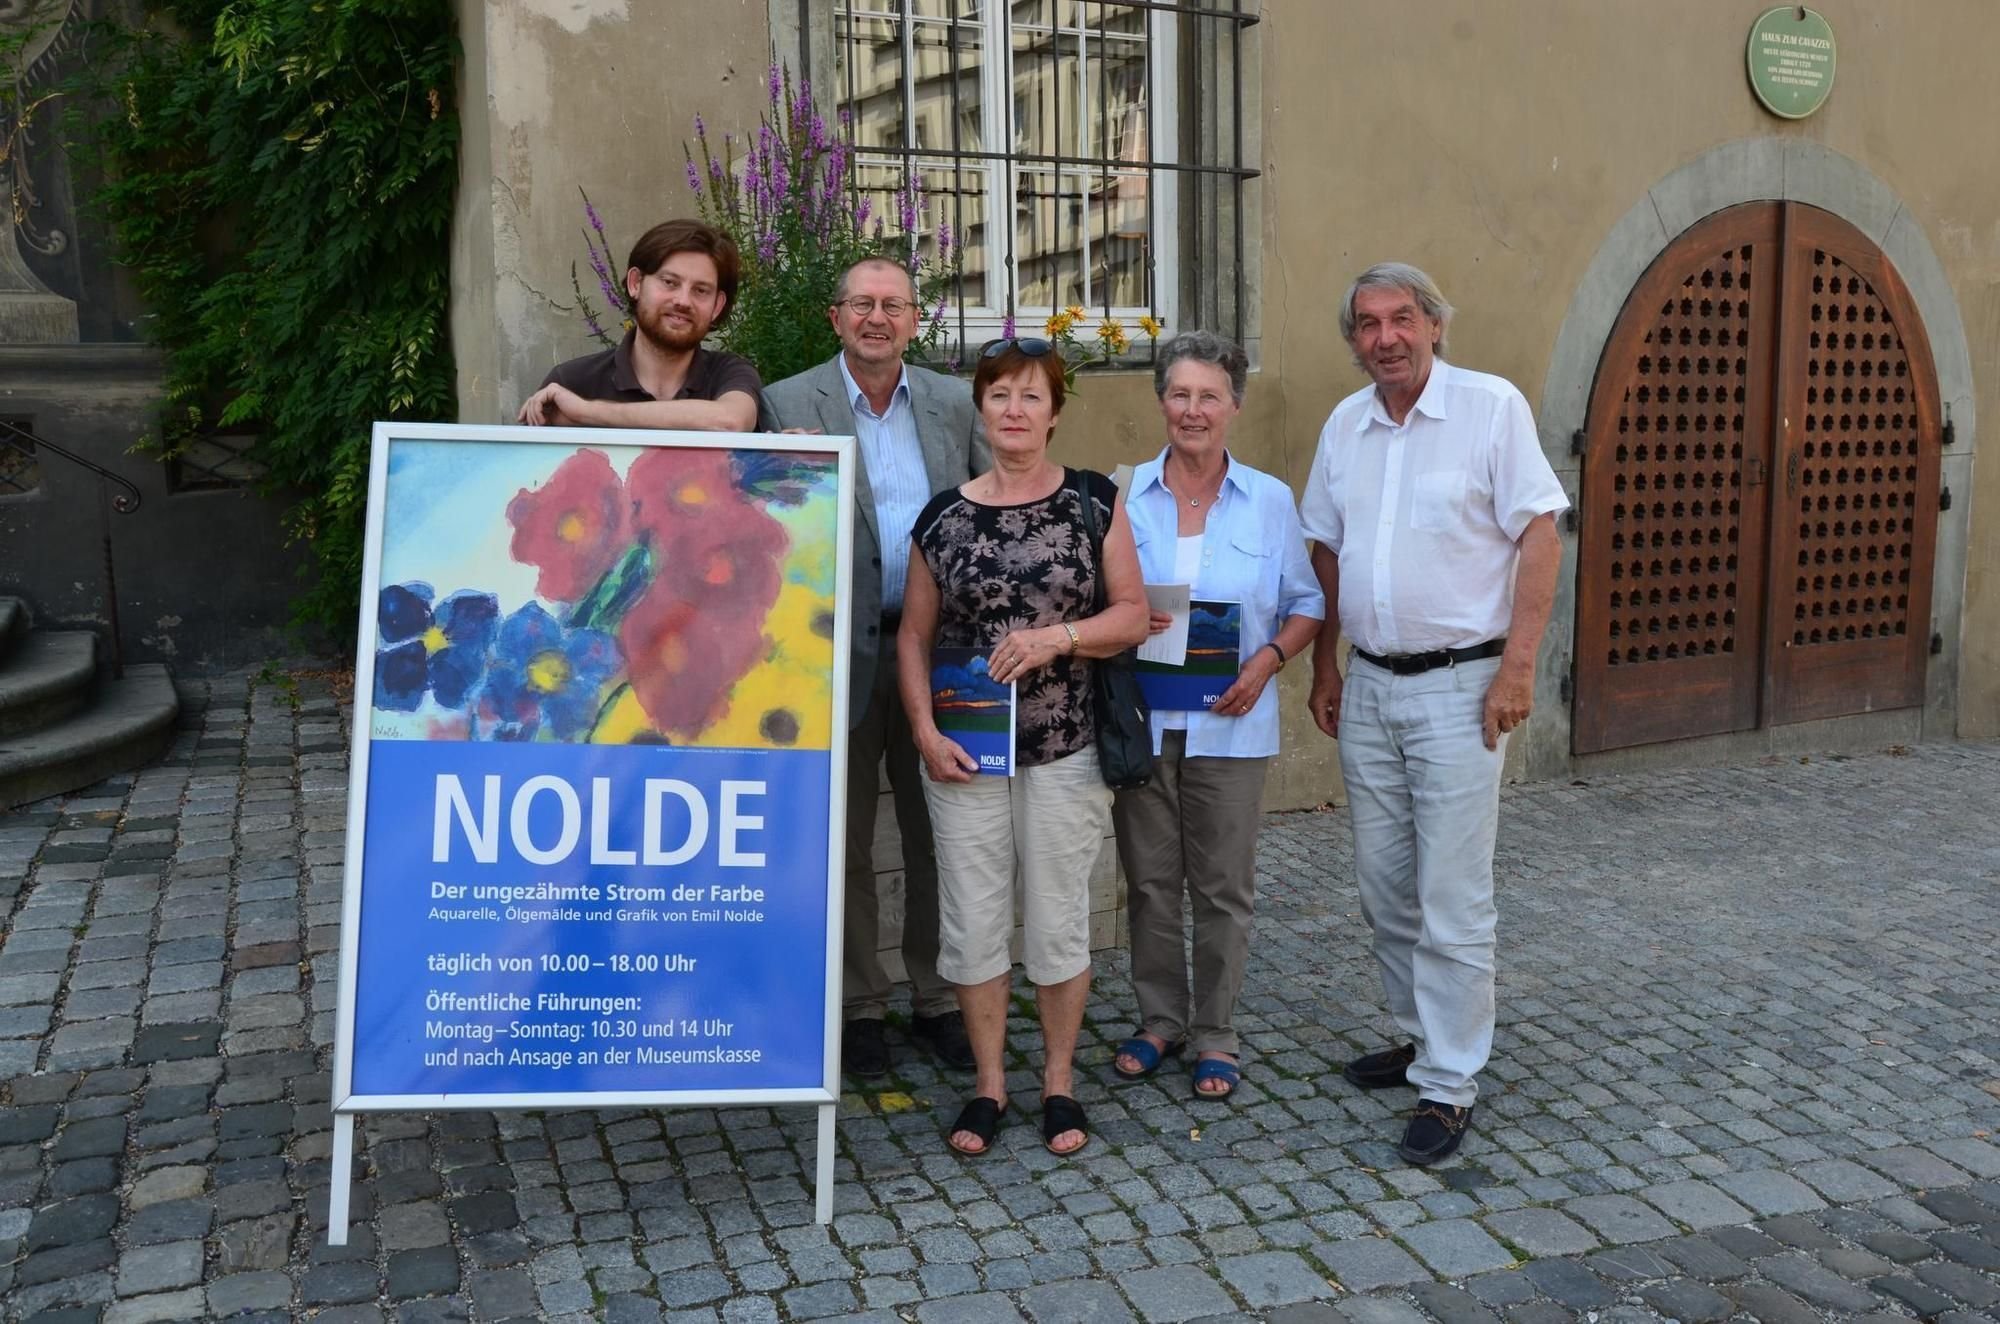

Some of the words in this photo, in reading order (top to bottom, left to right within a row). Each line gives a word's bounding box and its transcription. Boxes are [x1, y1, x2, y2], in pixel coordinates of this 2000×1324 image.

[1762, 31, 1781, 43] HAUS
[1782, 34, 1798, 46] ZUM
[1798, 36, 1831, 49] CAVAZZEN
[980, 754, 1006, 767] NOLDE
[432, 774, 767, 867] NOLDE
[431, 881, 467, 899] Der
[473, 881, 600, 904] ungezähmte
[606, 883, 666, 902] Strom
[671, 883, 705, 902] der
[710, 884, 765, 902] Farbe
[428, 906, 501, 922] Aquarelle,
[505, 905, 581, 923] Ölgemälde
[586, 908, 612, 921] und
[616, 908, 659, 922] Grafik
[662, 911, 688, 922] von
[692, 909, 720, 922] Emil
[724, 909, 765, 922] Nolde
[427, 952, 492, 976] täglich
[498, 957, 533, 972] von
[664, 953, 697, 973] Uhr
[425, 990, 531, 1012] Öffentliche
[537, 992, 642, 1016] Führungen:
[591, 1019, 637, 1038] 10.30
[642, 1018, 674, 1038] und
[679, 1019, 699, 1037] 14
[704, 1018, 734, 1037] Uhr
[424, 1047, 458, 1066] und
[463, 1047, 505, 1066] nach
[508, 1047, 573, 1070] Ansage
[577, 1051, 599, 1065] an
[603, 1046, 632, 1065] der
[636, 1045, 762, 1065] Museumskasse
